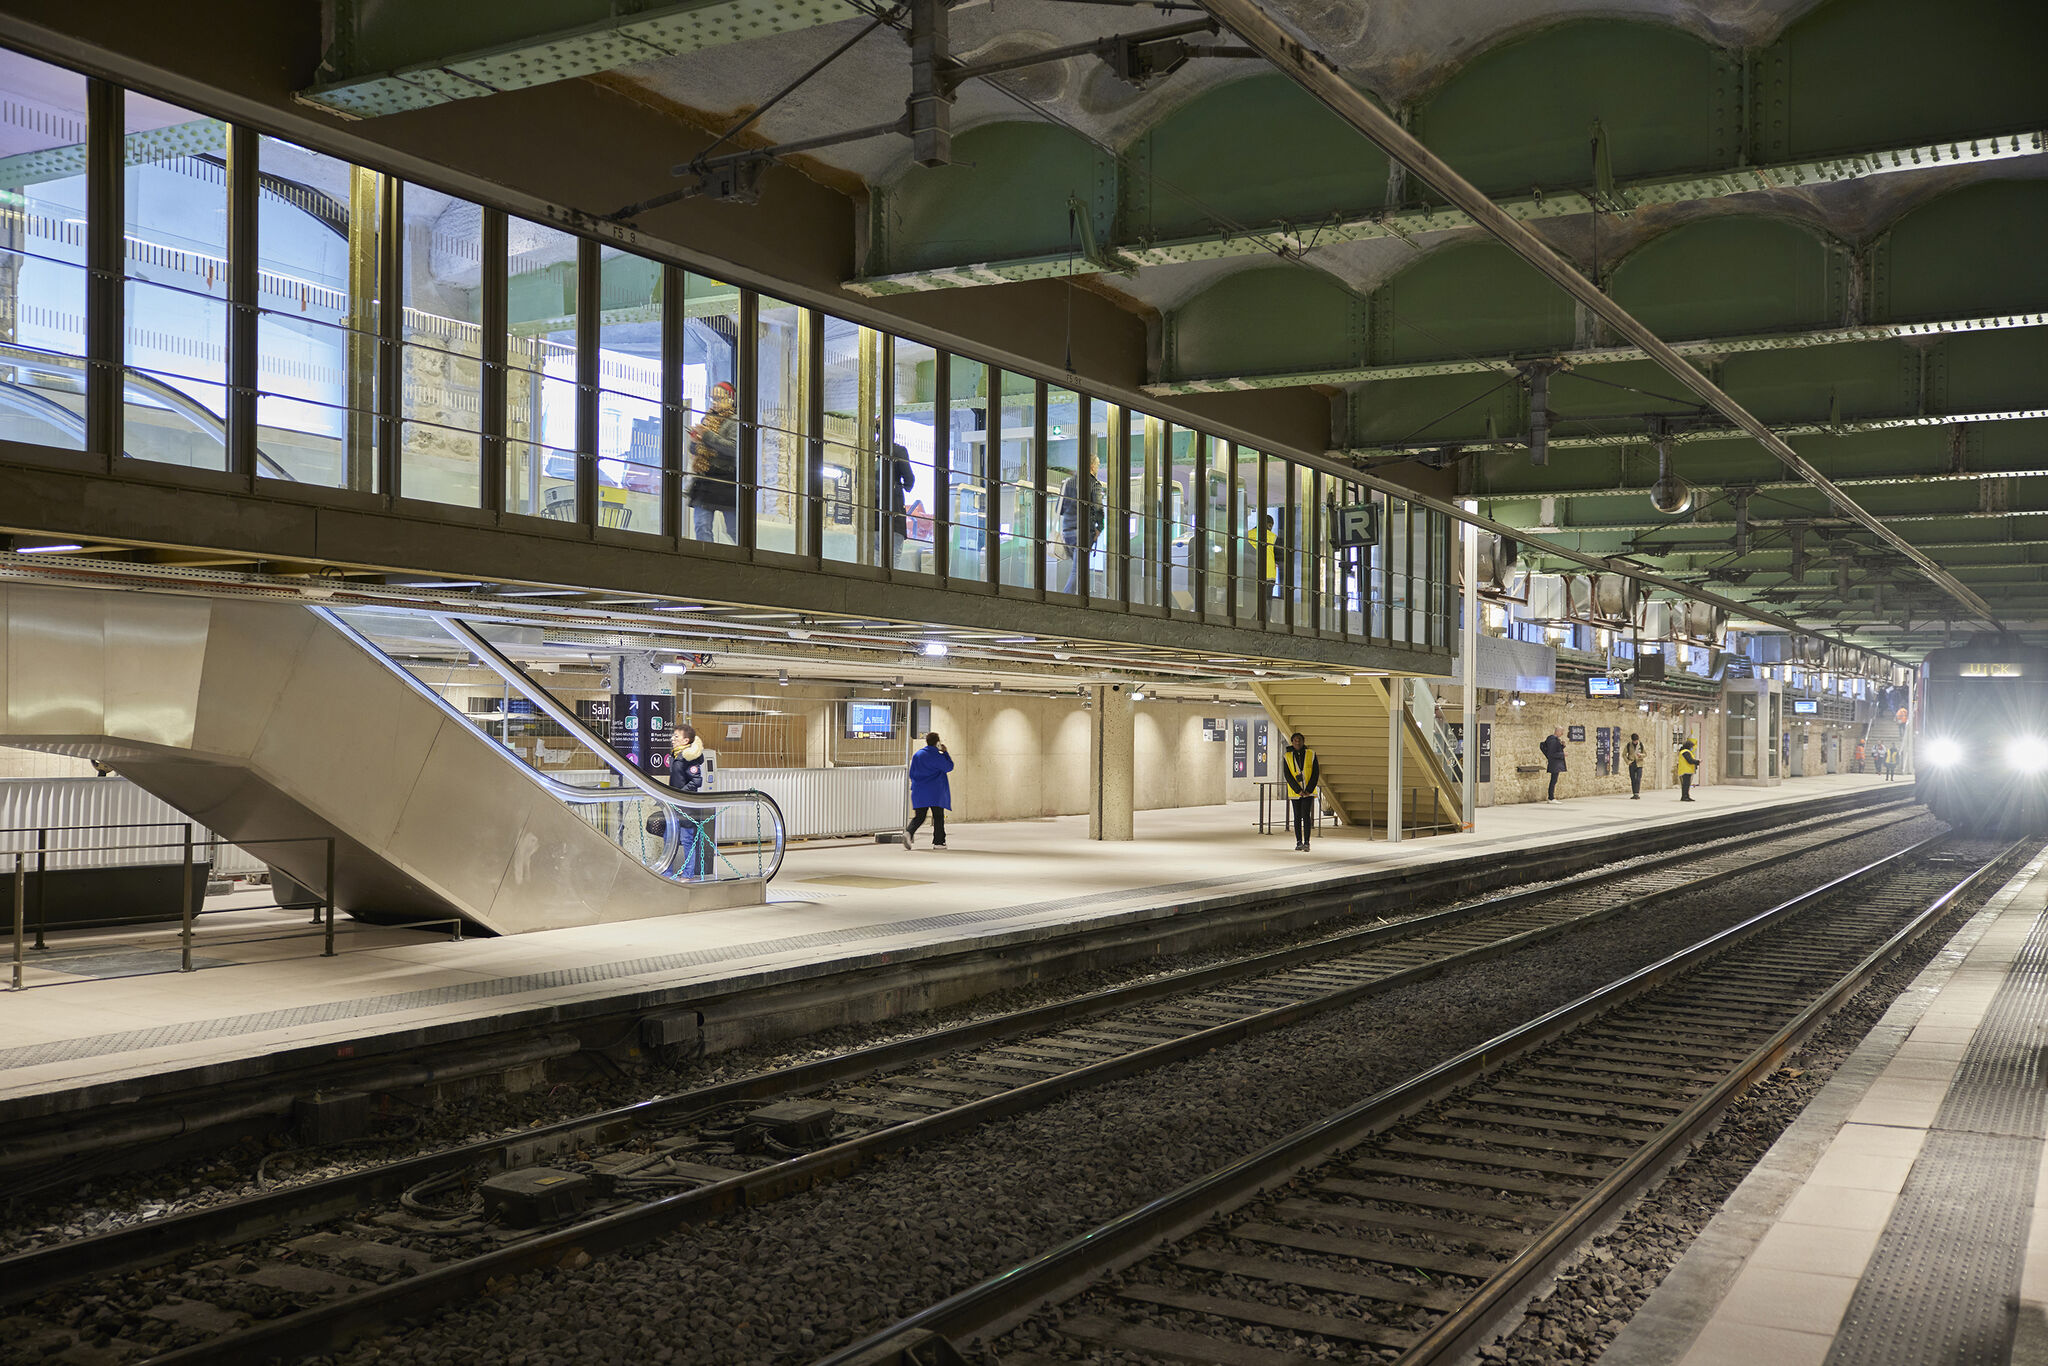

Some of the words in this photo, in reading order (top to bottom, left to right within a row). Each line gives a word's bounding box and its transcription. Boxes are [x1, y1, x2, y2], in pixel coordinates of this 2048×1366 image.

[613, 226, 624, 240] F5
[630, 232, 636, 243] 9
[1345, 511, 1371, 541] R
